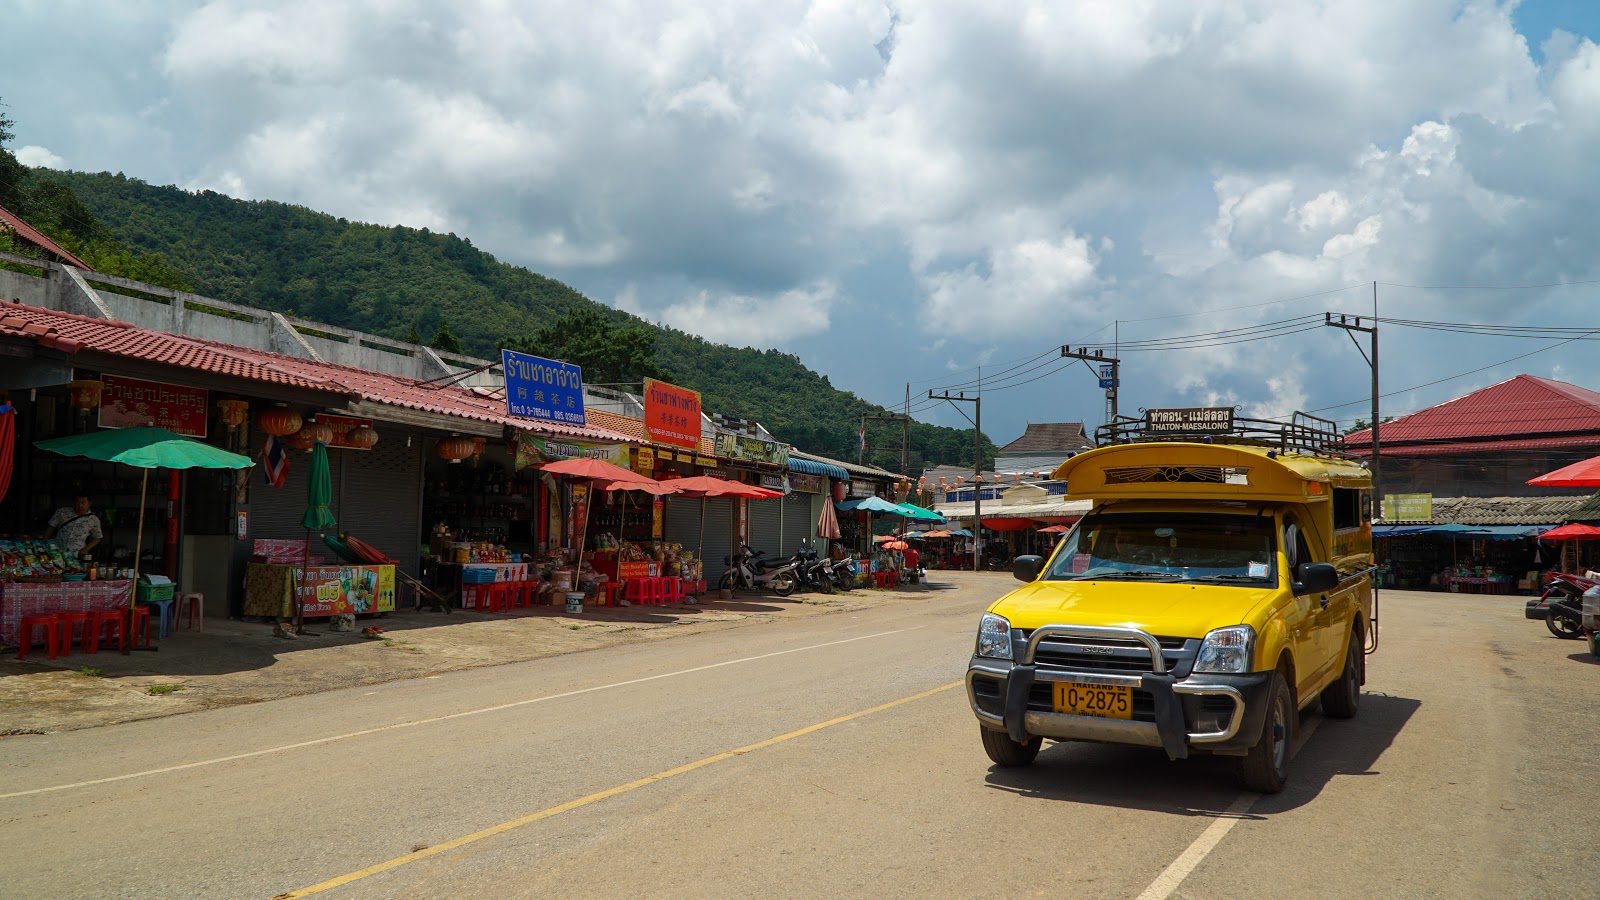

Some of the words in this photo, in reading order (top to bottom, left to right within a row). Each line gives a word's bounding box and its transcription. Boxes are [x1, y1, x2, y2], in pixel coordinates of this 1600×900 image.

[1189, 408, 1229, 421] แม่สลอง
[1152, 422, 1228, 431] THATON-MAESALONG
[317, 580, 340, 602] ฟรี
[1080, 647, 1114, 655] ISUZU
[1072, 682, 1113, 690] THAILAND
[1061, 688, 1127, 712] 10-2875
